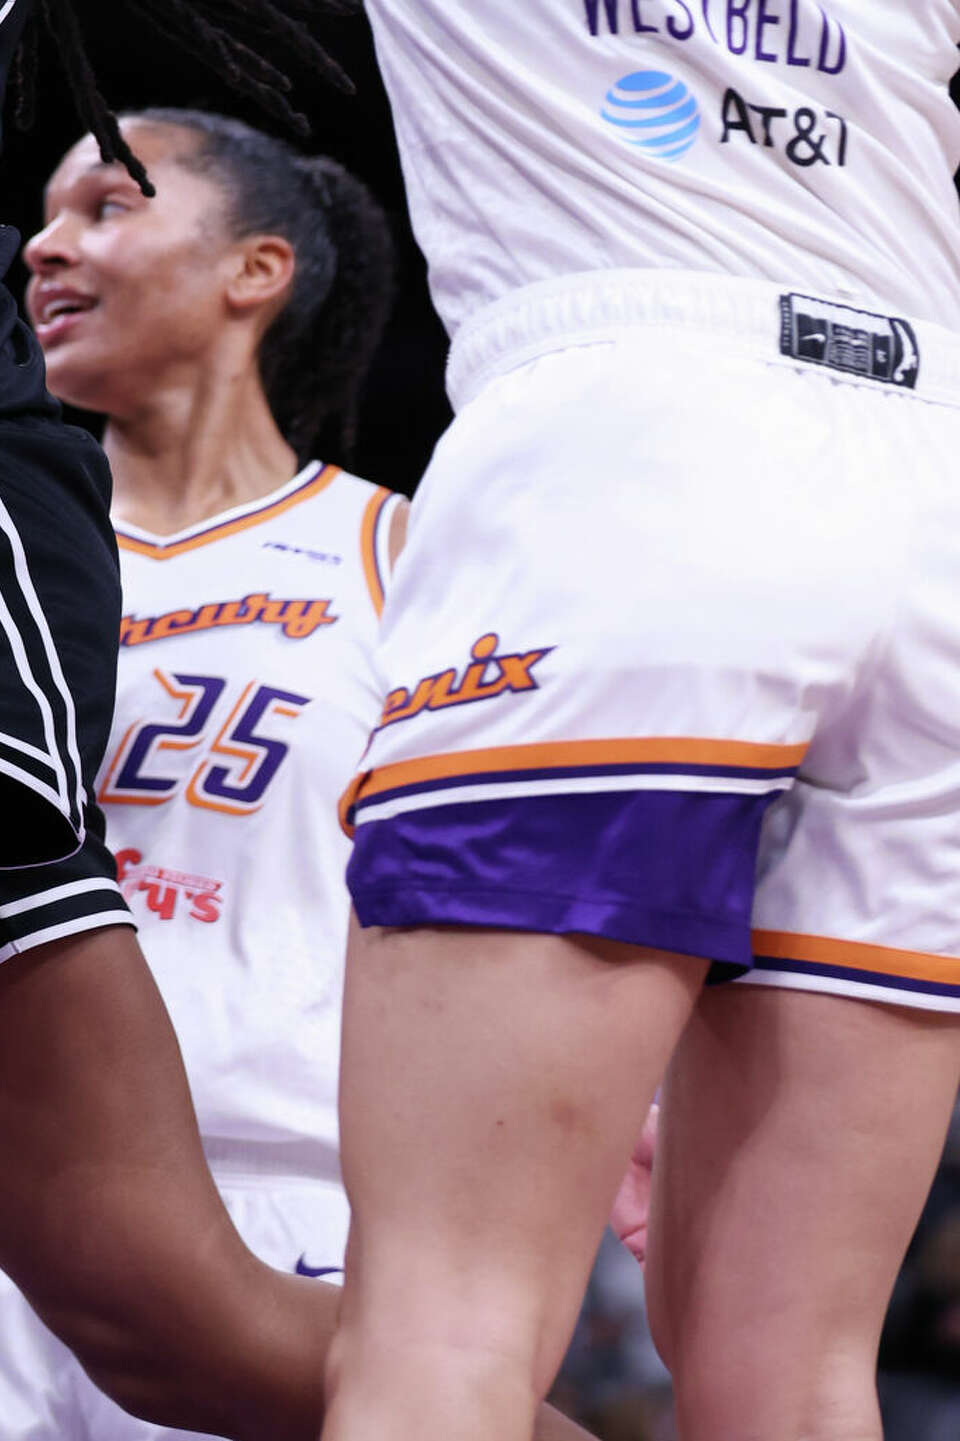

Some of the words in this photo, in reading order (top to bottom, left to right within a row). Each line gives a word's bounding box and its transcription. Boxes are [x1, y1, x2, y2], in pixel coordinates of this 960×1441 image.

[720, 87, 848, 168] AT&T
[380, 632, 558, 727] enix
[96, 668, 312, 815] 25
